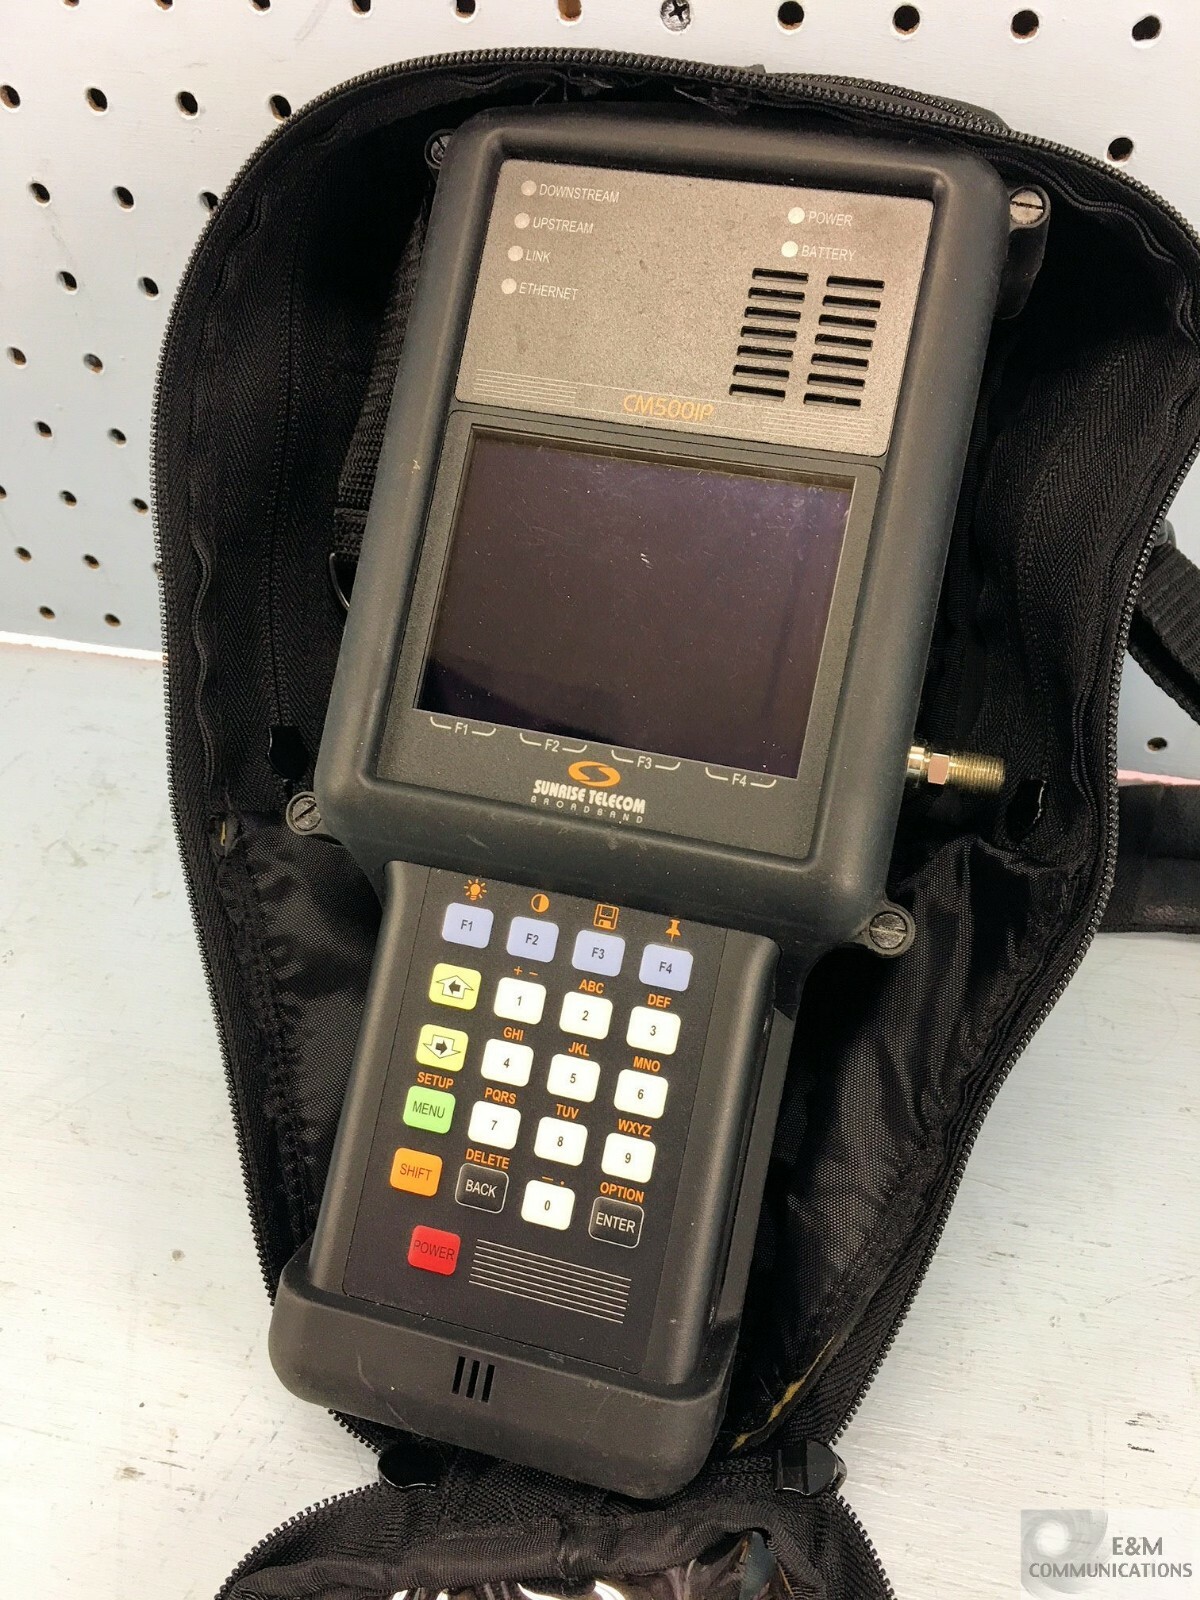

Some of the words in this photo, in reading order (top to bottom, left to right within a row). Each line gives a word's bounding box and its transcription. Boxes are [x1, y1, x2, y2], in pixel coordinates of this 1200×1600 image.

[539, 183, 620, 203] DOWNSTREAM
[533, 216, 594, 234] UPSTREAM
[808, 211, 853, 227] POWER
[525, 249, 551, 264] LINK
[801, 245, 856, 262] BATTERY
[518, 282, 578, 301] ETHERNET
[622, 394, 714, 422] CM500IP
[454, 722, 468, 736] F1
[545, 739, 559, 753] F2
[637, 755, 652, 770] F3
[732, 773, 747, 787] F4
[533, 779, 586, 803] SUNRISE
[588, 789, 646, 815] TELECOM
[531, 795, 644, 825] BROADBAND
[460, 919, 473, 932] F1
[525, 933, 539, 946] F2
[591, 947, 605, 960] F3
[658, 961, 673, 975] F4
[579, 979, 605, 995] ABC
[516, 996, 523, 1007] 1
[647, 993, 672, 1008] DEF
[581, 1010, 589, 1021] 2
[503, 1026, 524, 1041] GHI
[650, 1025, 657, 1036] 3
[568, 1042, 590, 1057] JKL
[503, 1057, 511, 1069] 4
[633, 1056, 661, 1072] MNO
[417, 1071, 454, 1089] SETUP
[569, 1073, 577, 1084] 5
[484, 1087, 517, 1105] PQRS
[637, 1089, 644, 1100] 6
[412, 1101, 446, 1119] MENU
[555, 1104, 580, 1119] TUV
[490, 1120, 498, 1131] 7
[617, 1119, 652, 1137] WXYZ
[557, 1136, 564, 1147] 8
[465, 1149, 510, 1169] DELETE
[624, 1153, 631, 1164] 9
[399, 1163, 433, 1181] SHIFT
[465, 1179, 499, 1198] BACK
[600, 1182, 644, 1203] OPTION
[595, 1213, 636, 1233] ENTER
[414, 1240, 455, 1261] POWER
